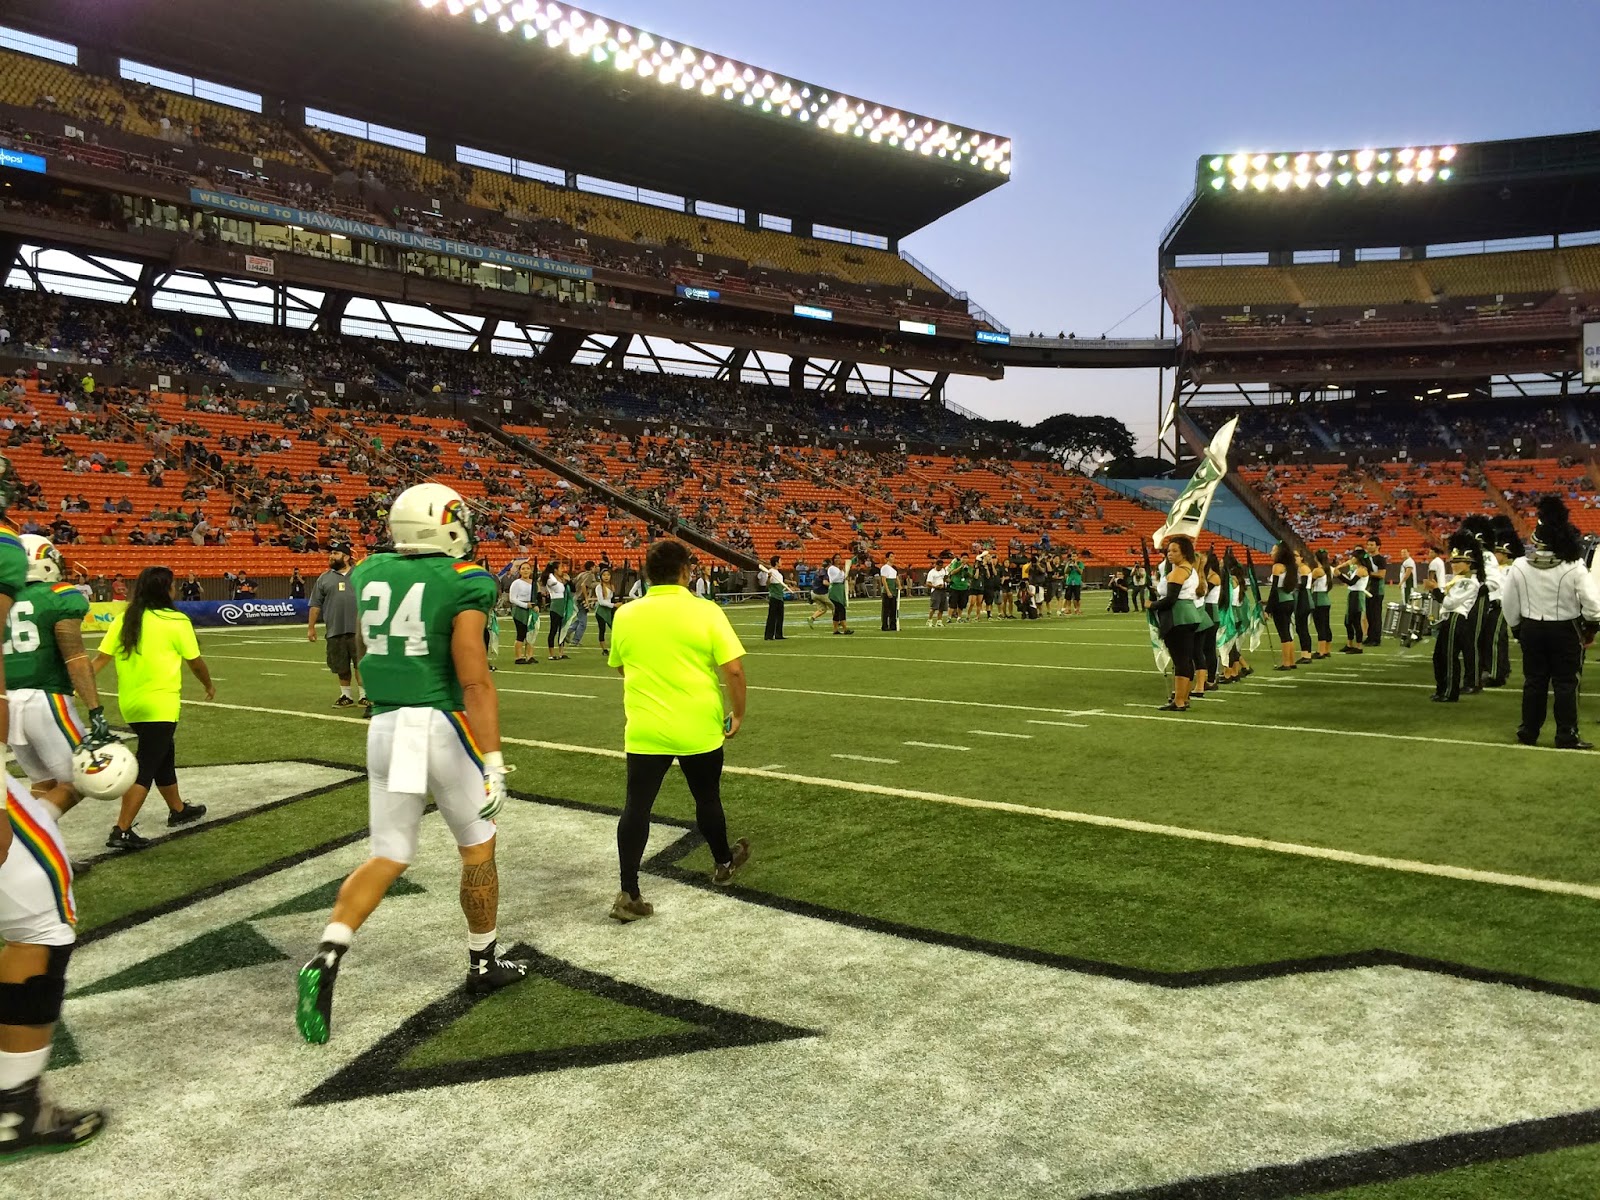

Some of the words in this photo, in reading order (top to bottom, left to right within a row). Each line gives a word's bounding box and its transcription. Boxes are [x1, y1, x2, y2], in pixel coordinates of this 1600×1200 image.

[199, 193, 269, 214] WELCOME
[274, 208, 292, 219] TO
[299, 211, 374, 237] HAWAIIAN
[377, 228, 442, 251] AIRLINES
[445, 242, 484, 258] FIELD
[488, 251, 502, 260] AT
[505, 254, 540, 268] ALOHA
[543, 262, 588, 276] STADIUM
[249, 257, 272, 267] ESPN
[243, 602, 294, 612] Oceanic
[361, 580, 430, 657] 24
